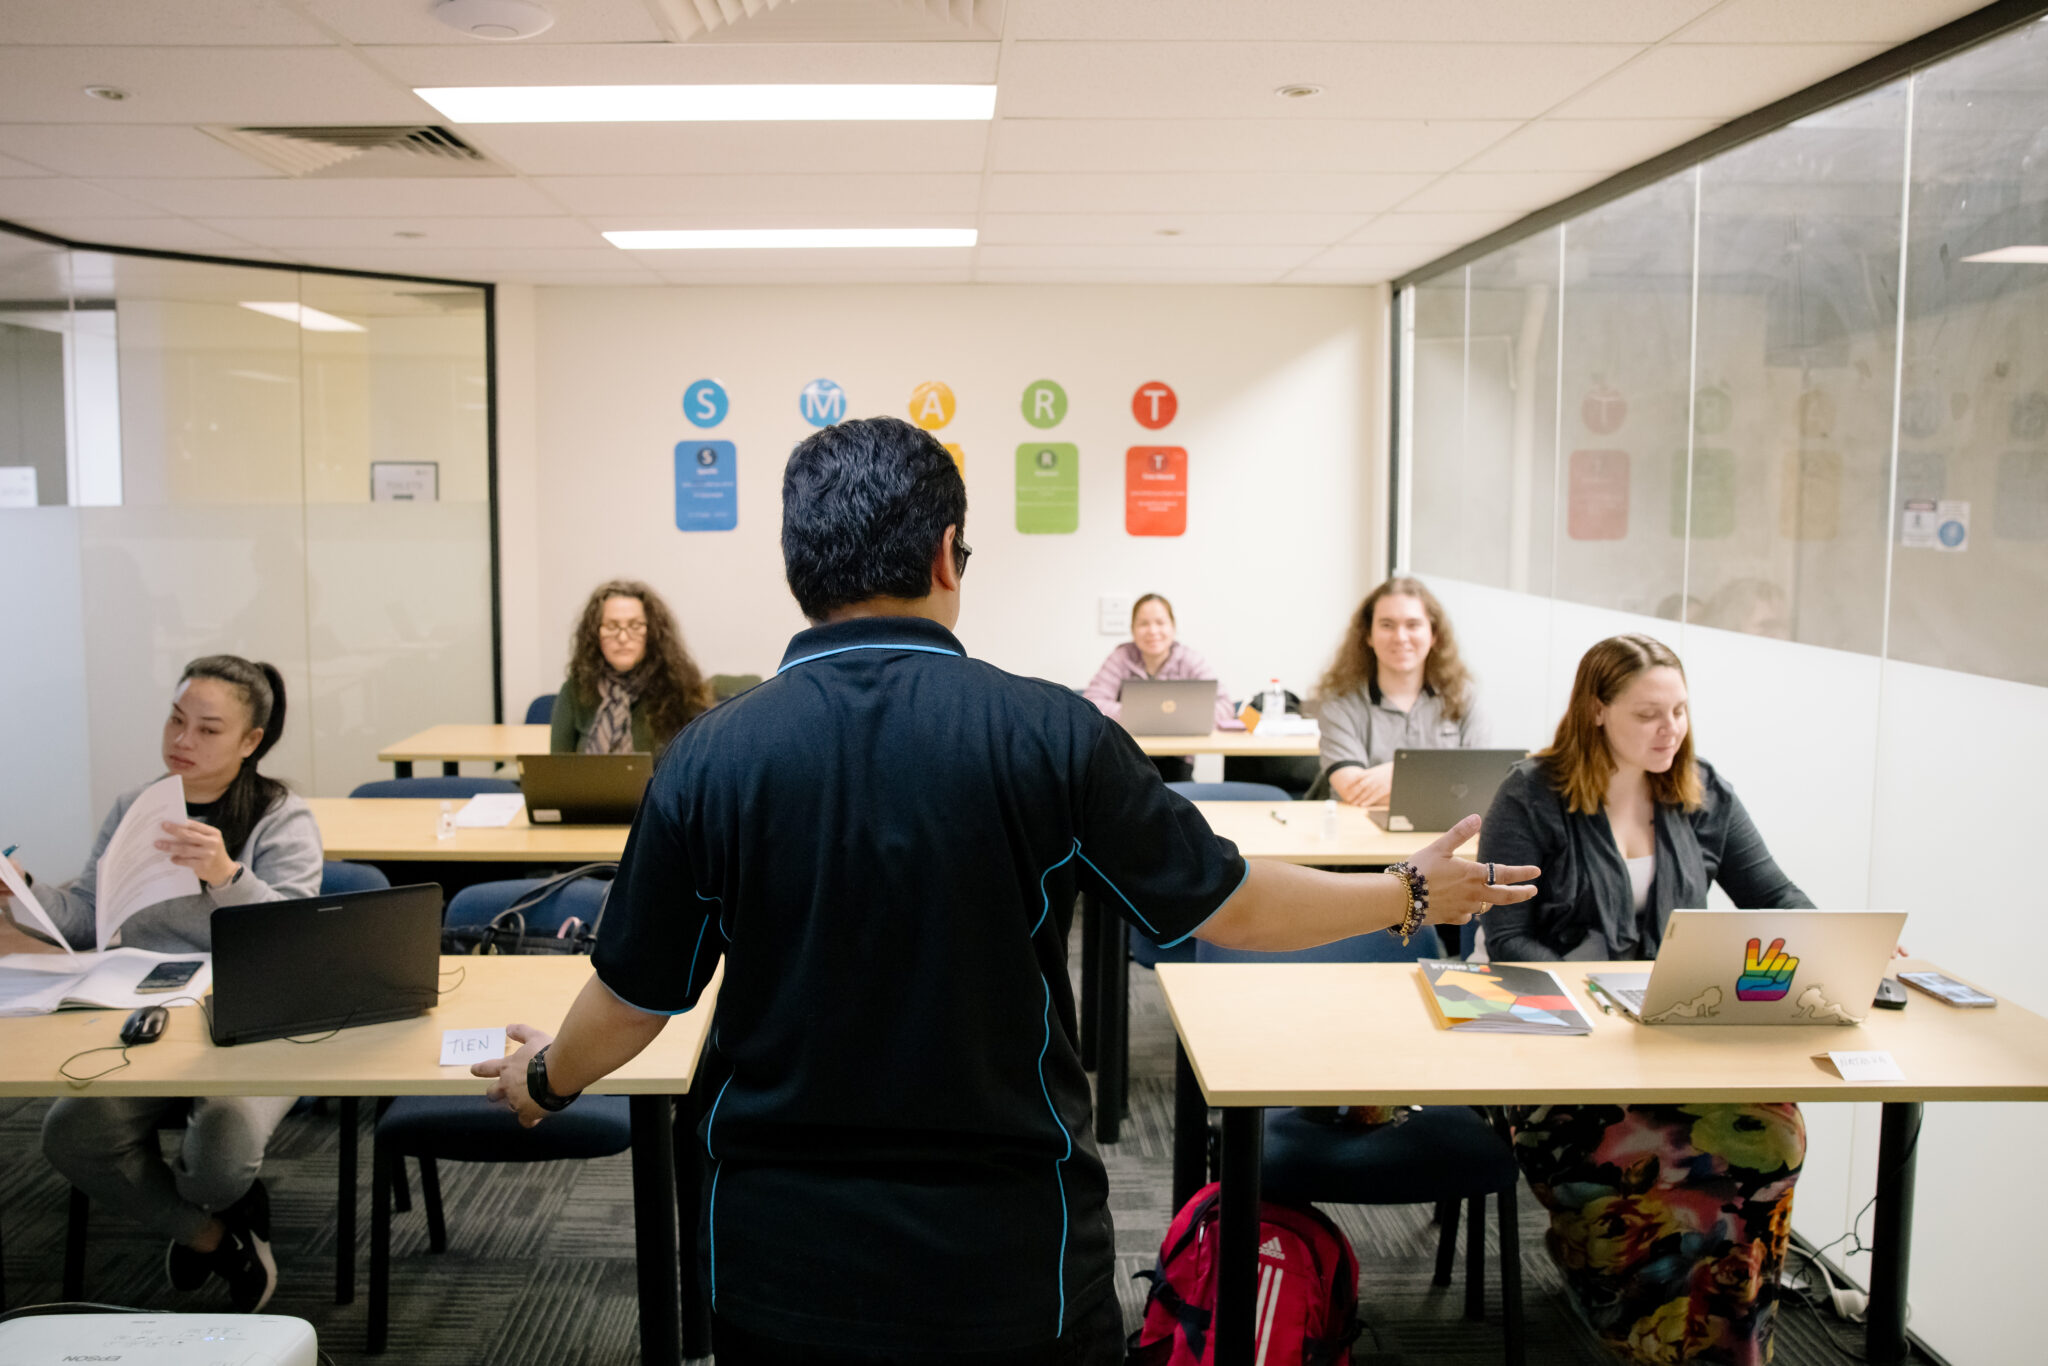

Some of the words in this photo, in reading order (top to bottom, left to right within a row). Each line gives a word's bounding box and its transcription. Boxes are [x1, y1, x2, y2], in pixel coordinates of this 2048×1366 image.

[696, 387, 717, 420] S
[806, 389, 840, 419] M
[920, 391, 945, 421] A
[1034, 389, 1056, 420] R
[1143, 389, 1167, 421] T
[702, 449, 713, 465] S
[447, 1035, 489, 1054] TIEN
